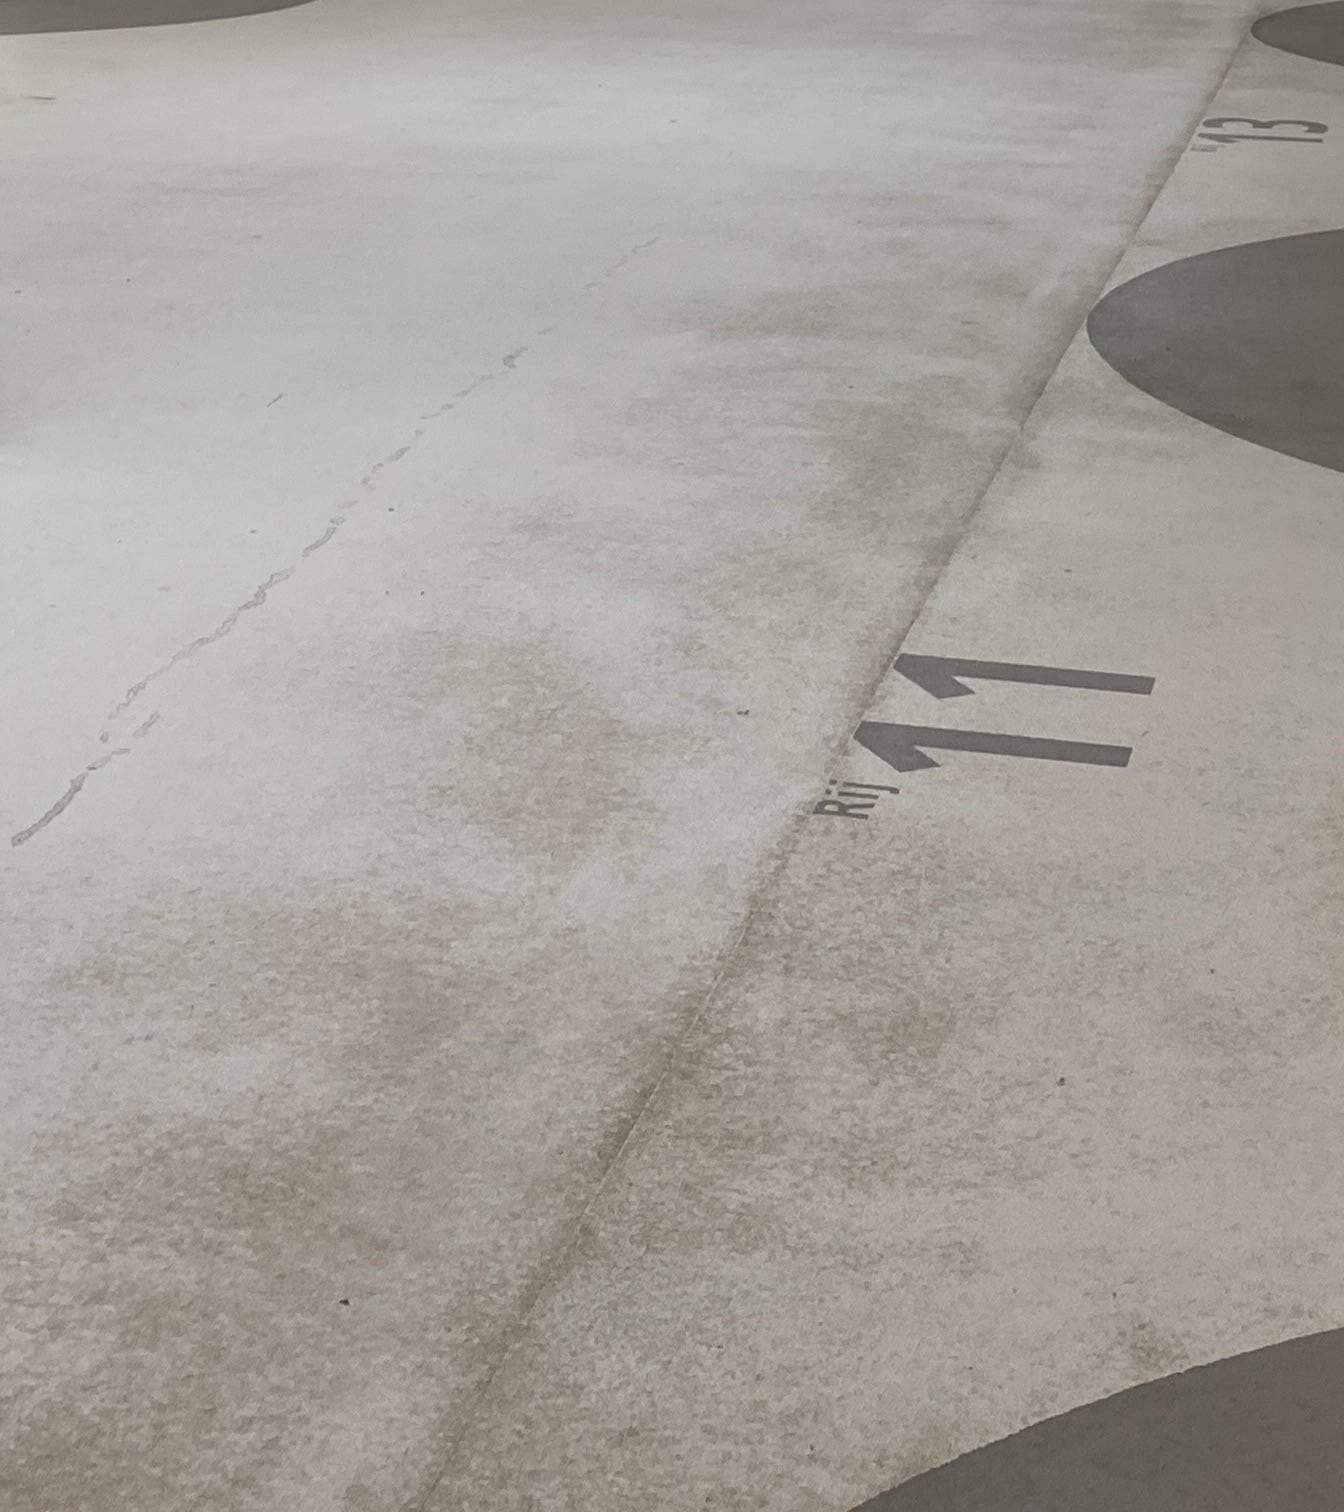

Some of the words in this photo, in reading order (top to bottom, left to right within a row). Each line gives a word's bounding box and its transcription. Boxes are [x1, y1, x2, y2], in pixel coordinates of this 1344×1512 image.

[1197, 117, 1329, 144] 13
[853, 653, 1156, 773] 11
[812, 779, 900, 819] Rij
